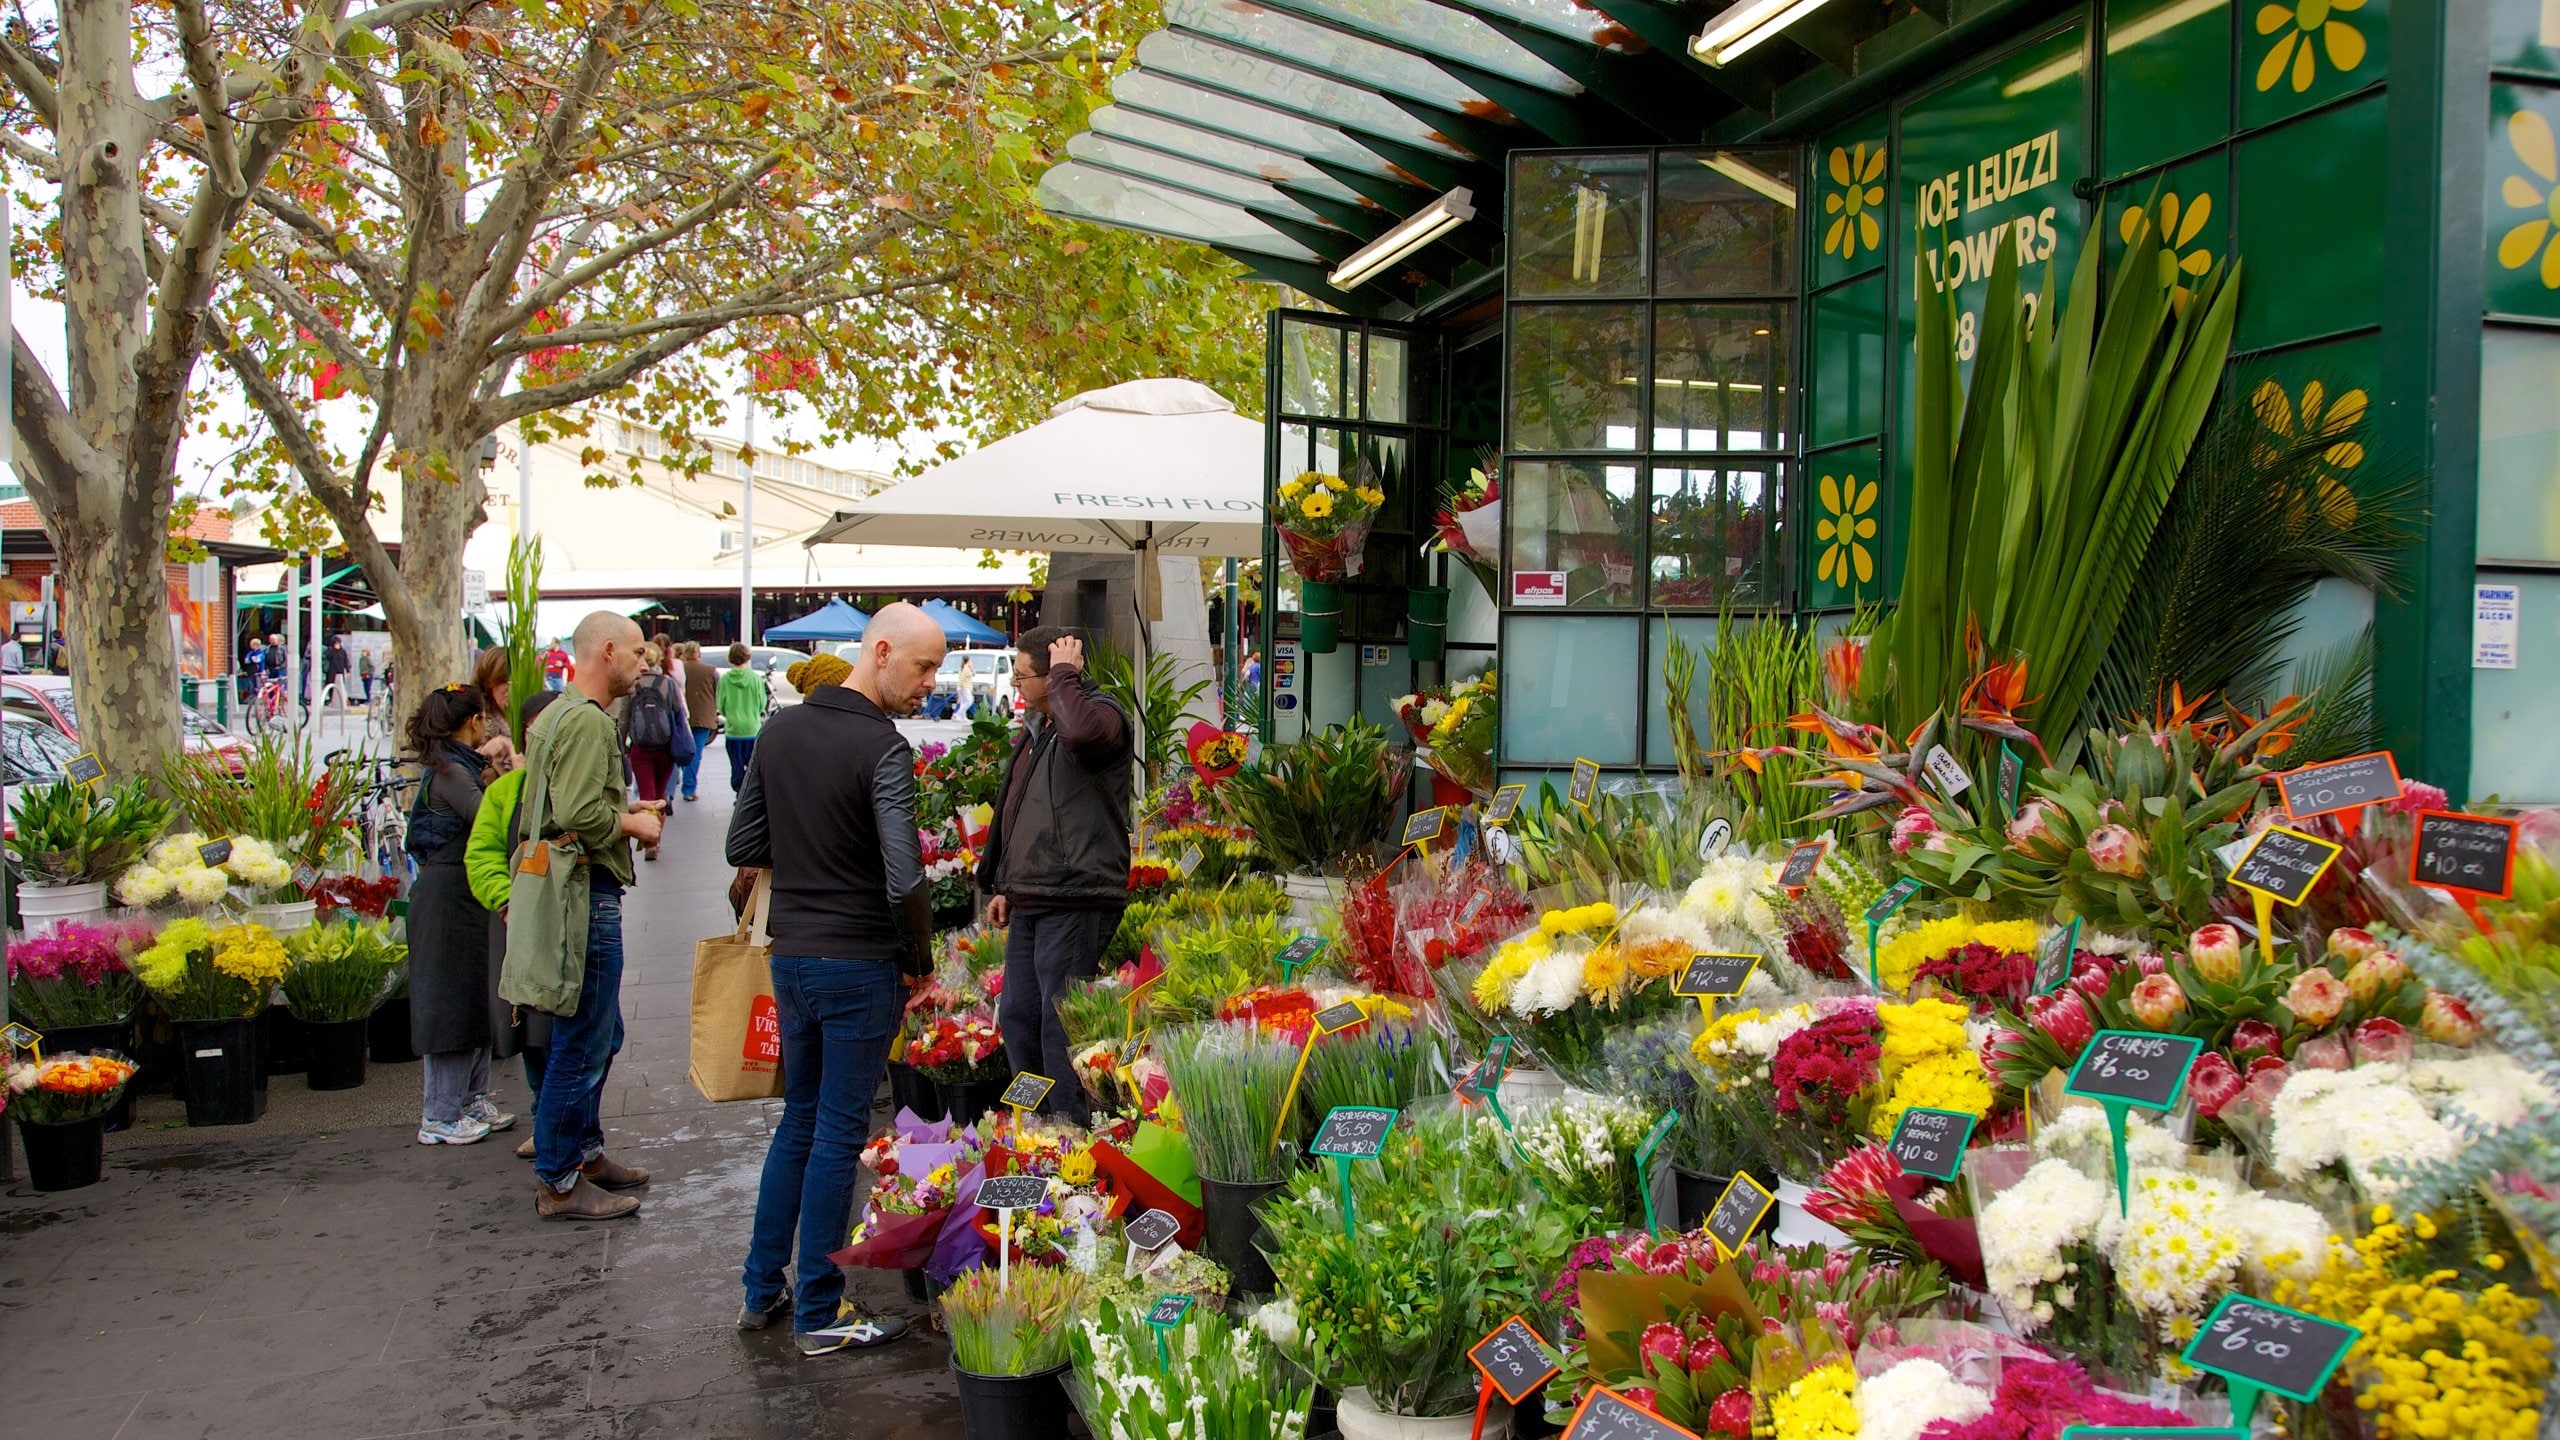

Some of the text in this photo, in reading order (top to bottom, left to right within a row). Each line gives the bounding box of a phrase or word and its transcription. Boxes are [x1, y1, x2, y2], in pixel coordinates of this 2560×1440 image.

[1915, 129, 2058, 231] JOE LEUZZI
[1914, 206, 2057, 301] LOWRS
[1054, 492, 1174, 510] FRESH
[1524, 585, 1554, 595] eftpos
[2478, 589, 2515, 600] WARNING
[1277, 647, 1294, 655] VISA
[1696, 957, 1748, 967] SEA HOLLY
[1335, 1121, 1372, 1137] $6.50
[1320, 1136, 1334, 1151] 2
[1333, 1143, 1348, 1153] FOR
